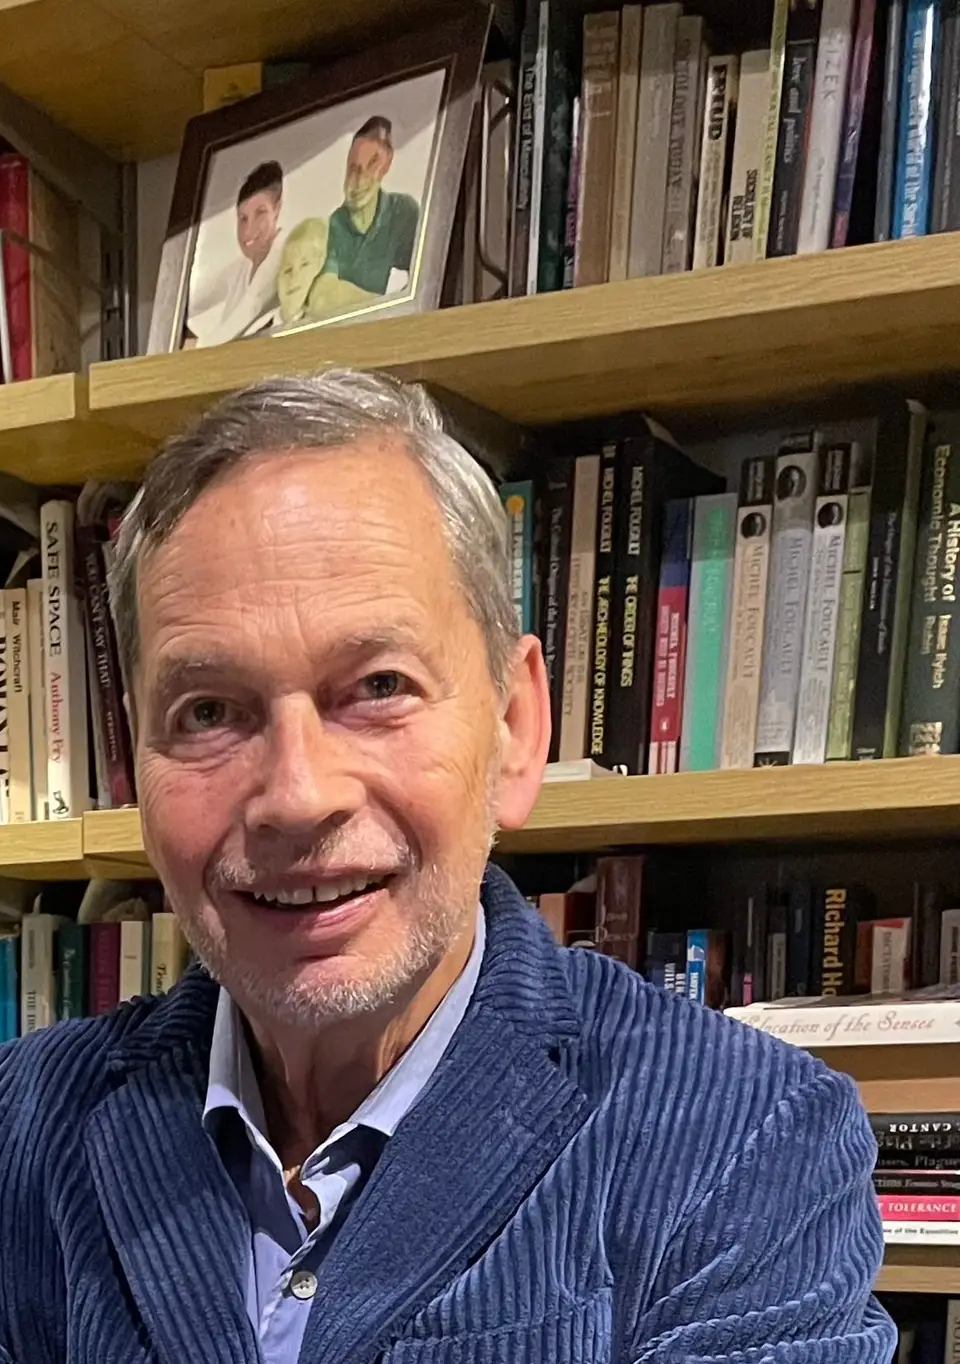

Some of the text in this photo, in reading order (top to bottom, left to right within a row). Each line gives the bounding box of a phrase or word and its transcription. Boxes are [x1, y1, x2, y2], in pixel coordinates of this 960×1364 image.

[522, 66, 535, 136] The End of
[708, 63, 730, 141] FREUD
[601, 467, 615, 505] MICHEL
[599, 506, 614, 553] FOUCAULT
[921, 444, 951, 603] Economic Thought
[941, 503, 960, 602] A History of
[597, 576, 611, 594] THE
[620, 466, 644, 687] MICHEL FOUCAULT THE ORDER OF THINGS
[823, 534, 842, 590] MICHEL
[84, 553, 106, 650] YOU SAY
[741, 543, 764, 680] MICHEL FOUCAULT
[778, 536, 804, 675] MICHEL FOUCAULT
[815, 598, 836, 673] FOUCAULT
[935, 613, 953, 651] Isaac
[11, 600, 24, 694] Mair Witchcraft
[45, 522, 66, 764] SAFE SPACE Anthony Fry
[593, 672, 608, 687] OF
[590, 688, 606, 755] KNOWLEDGE
[821, 887, 846, 968] Richard
[824, 1010, 935, 1041] of the Senses
[888, 1121, 953, 1134] CANTOR
[887, 1200, 958, 1214] TOLERANCE
